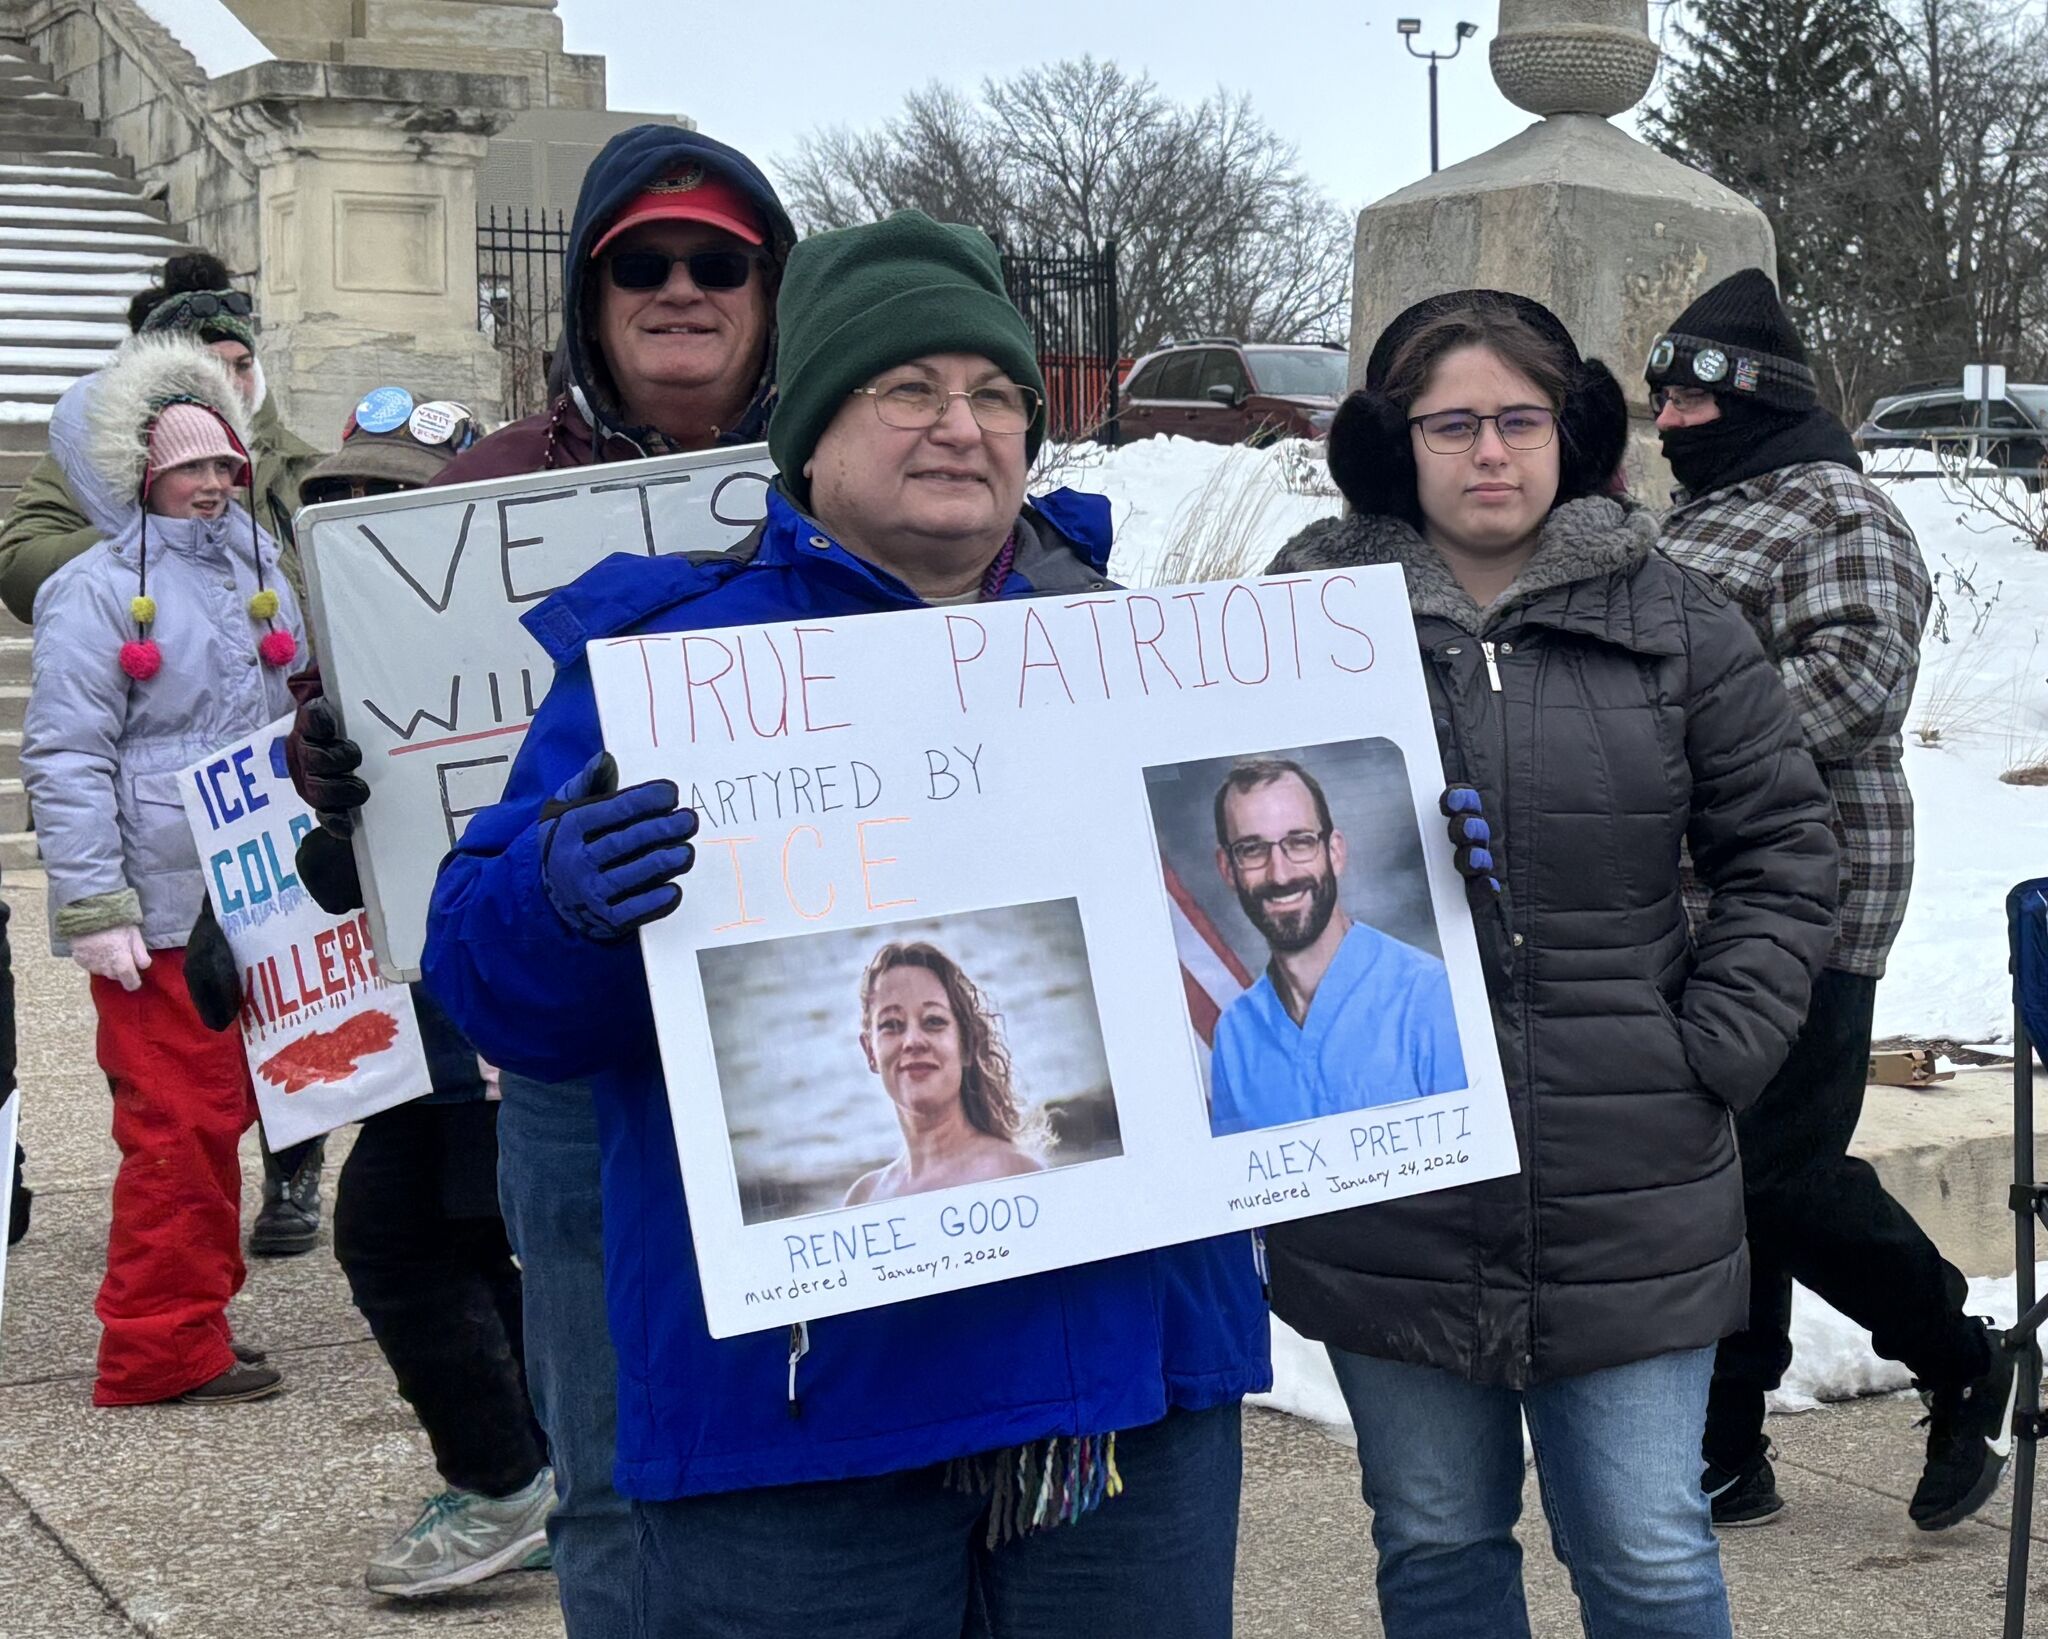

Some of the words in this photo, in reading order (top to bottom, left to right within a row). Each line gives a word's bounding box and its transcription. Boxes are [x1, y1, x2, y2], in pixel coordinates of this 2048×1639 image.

[606, 627, 852, 748] TRUE
[945, 576, 1375, 713] PATRIOTS
[363, 669, 540, 740] WIL
[194, 745, 270, 831] ICE
[692, 761, 882, 828] ARTYRED
[925, 744, 982, 800] BY
[703, 817, 917, 932] ICE
[1227, 1182, 1311, 1212] murdered
[1326, 1168, 1390, 1194] January
[1424, 1150, 1469, 1172] 2026
[1247, 1138, 1327, 1183] ALEX
[1350, 1106, 1472, 1161] PRETTI
[784, 1217, 916, 1273] RENEE
[940, 1195, 1039, 1237] GOOD
[744, 1269, 849, 1306] murdered
[872, 1260, 938, 1281] January
[963, 1246, 1010, 1265] 2026
